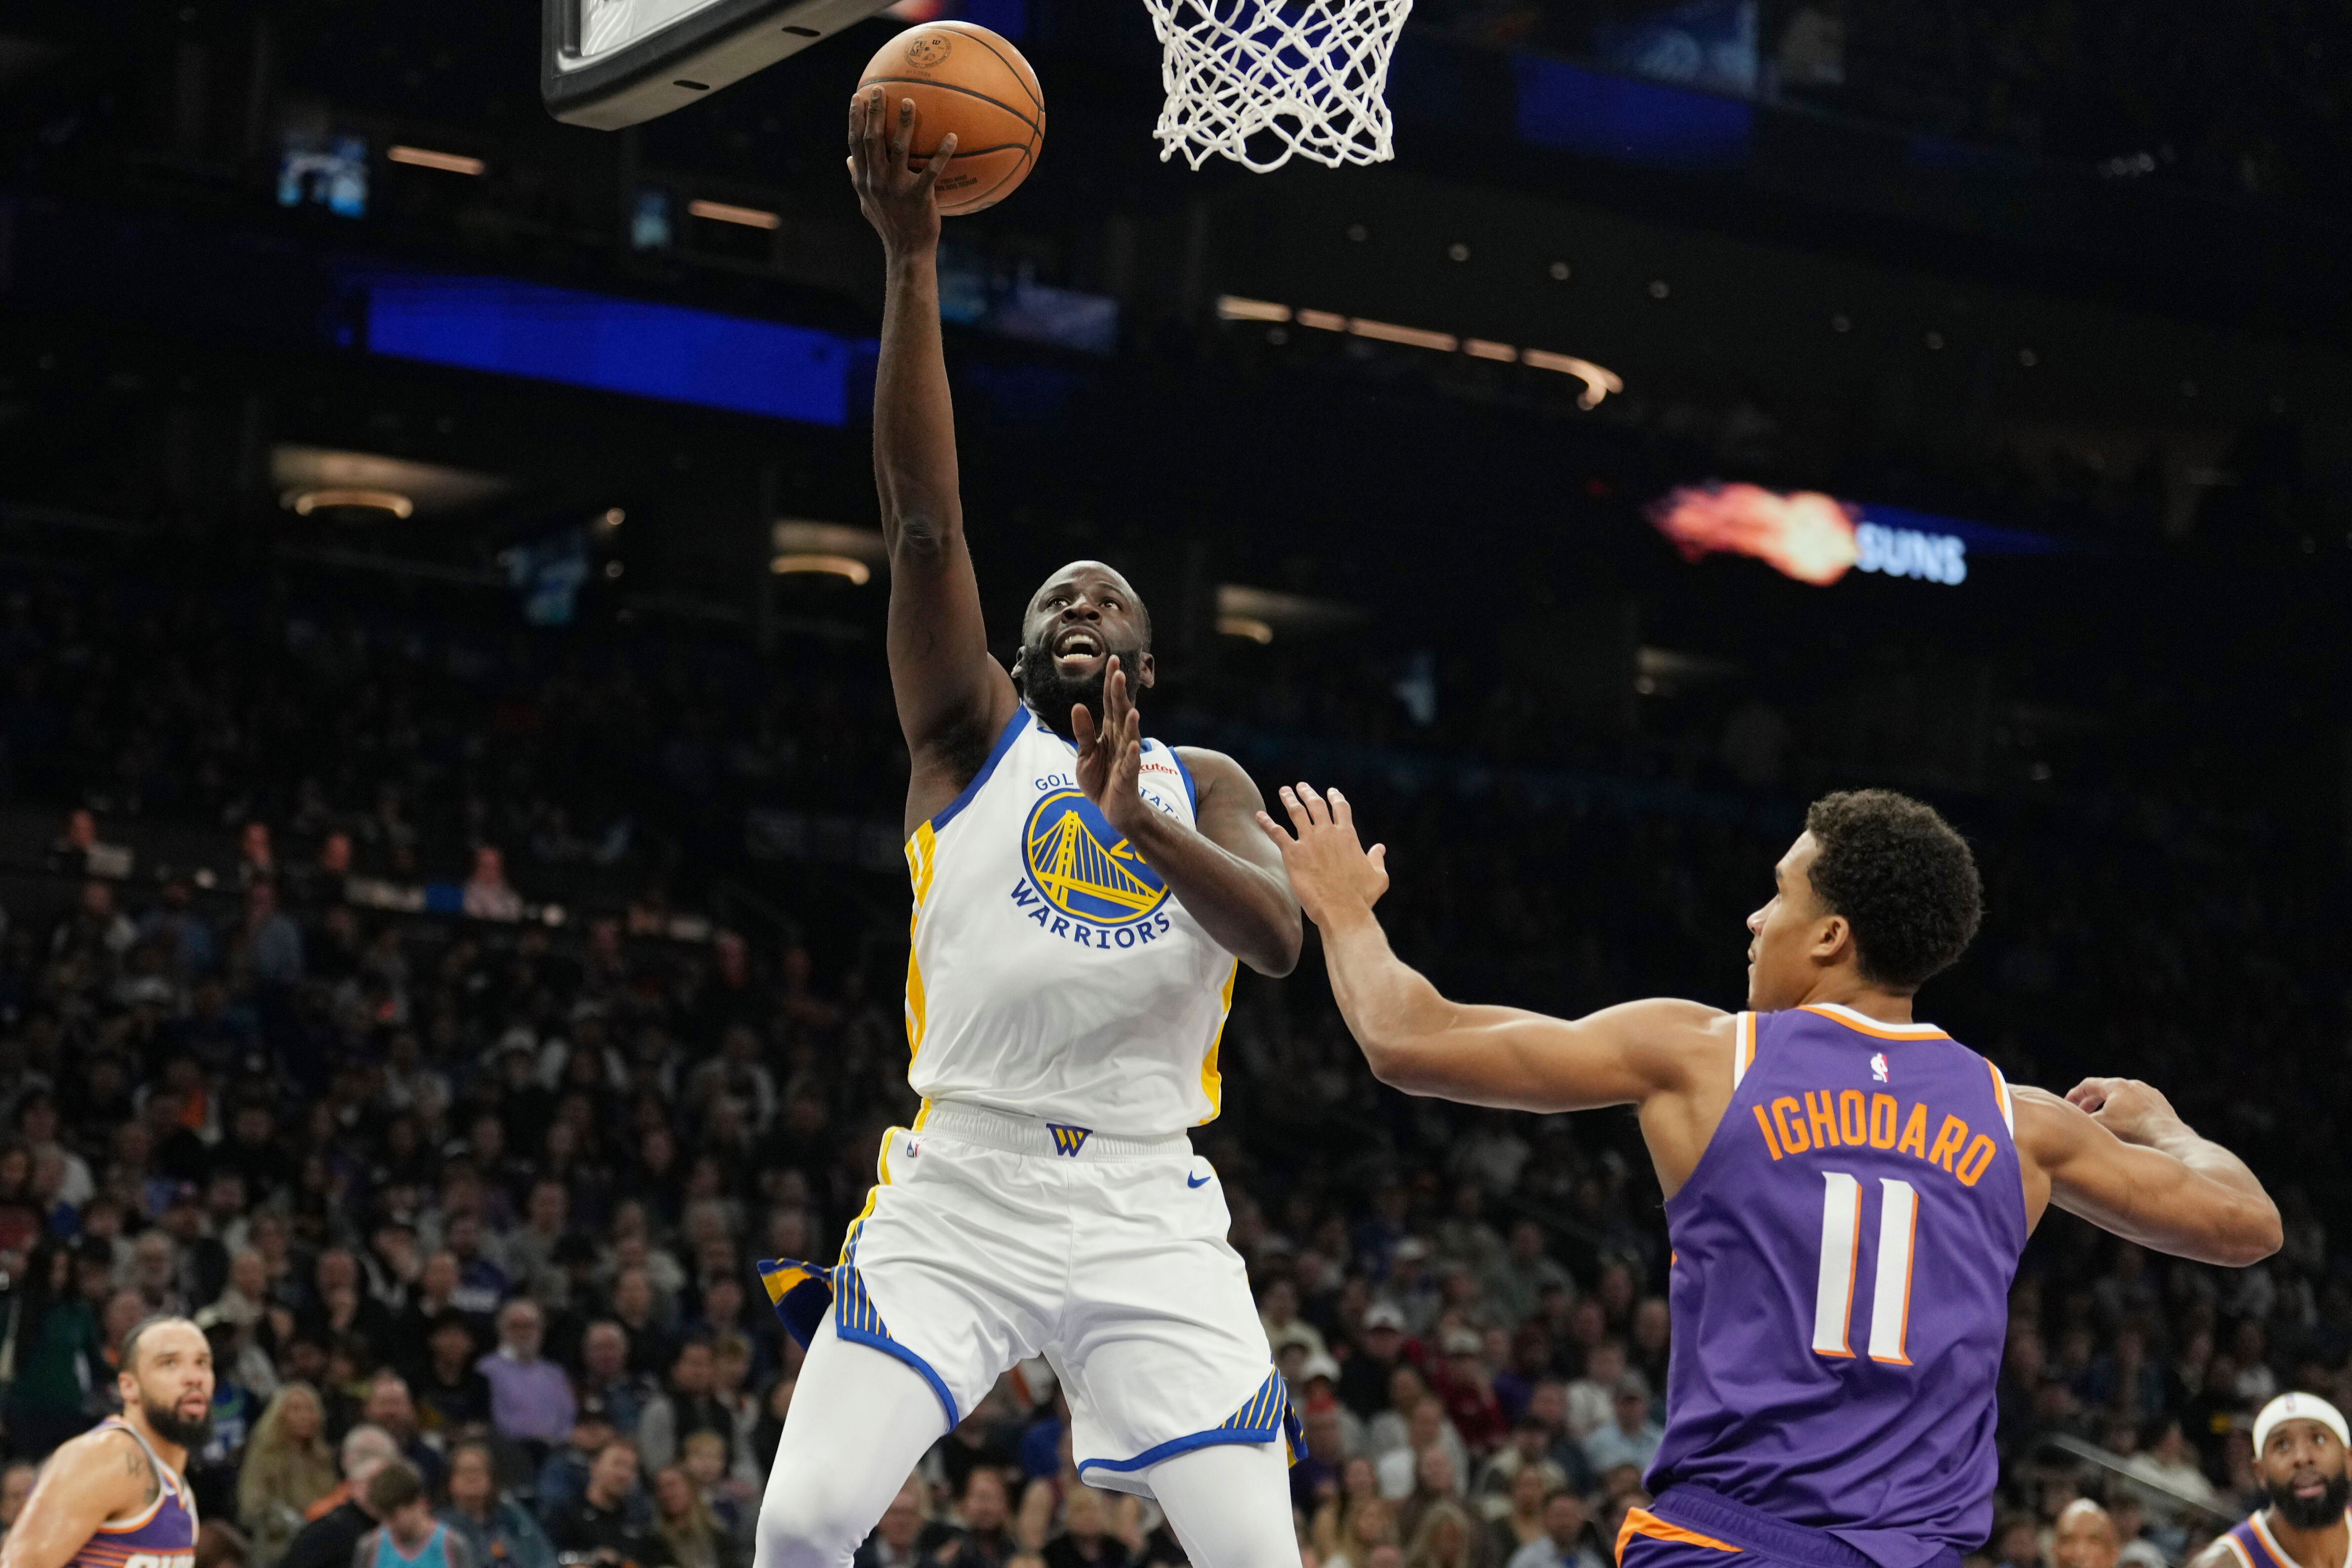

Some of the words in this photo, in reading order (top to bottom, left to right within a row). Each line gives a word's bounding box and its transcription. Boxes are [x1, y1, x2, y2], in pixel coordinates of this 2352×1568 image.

[1855, 522, 1967, 586] SUNS
[1139, 763, 1178, 775] kuten
[1010, 877, 1170, 949] WARRIORS
[1753, 1089, 1996, 1187] IGHODARO
[1812, 1171, 1919, 1366] 11
